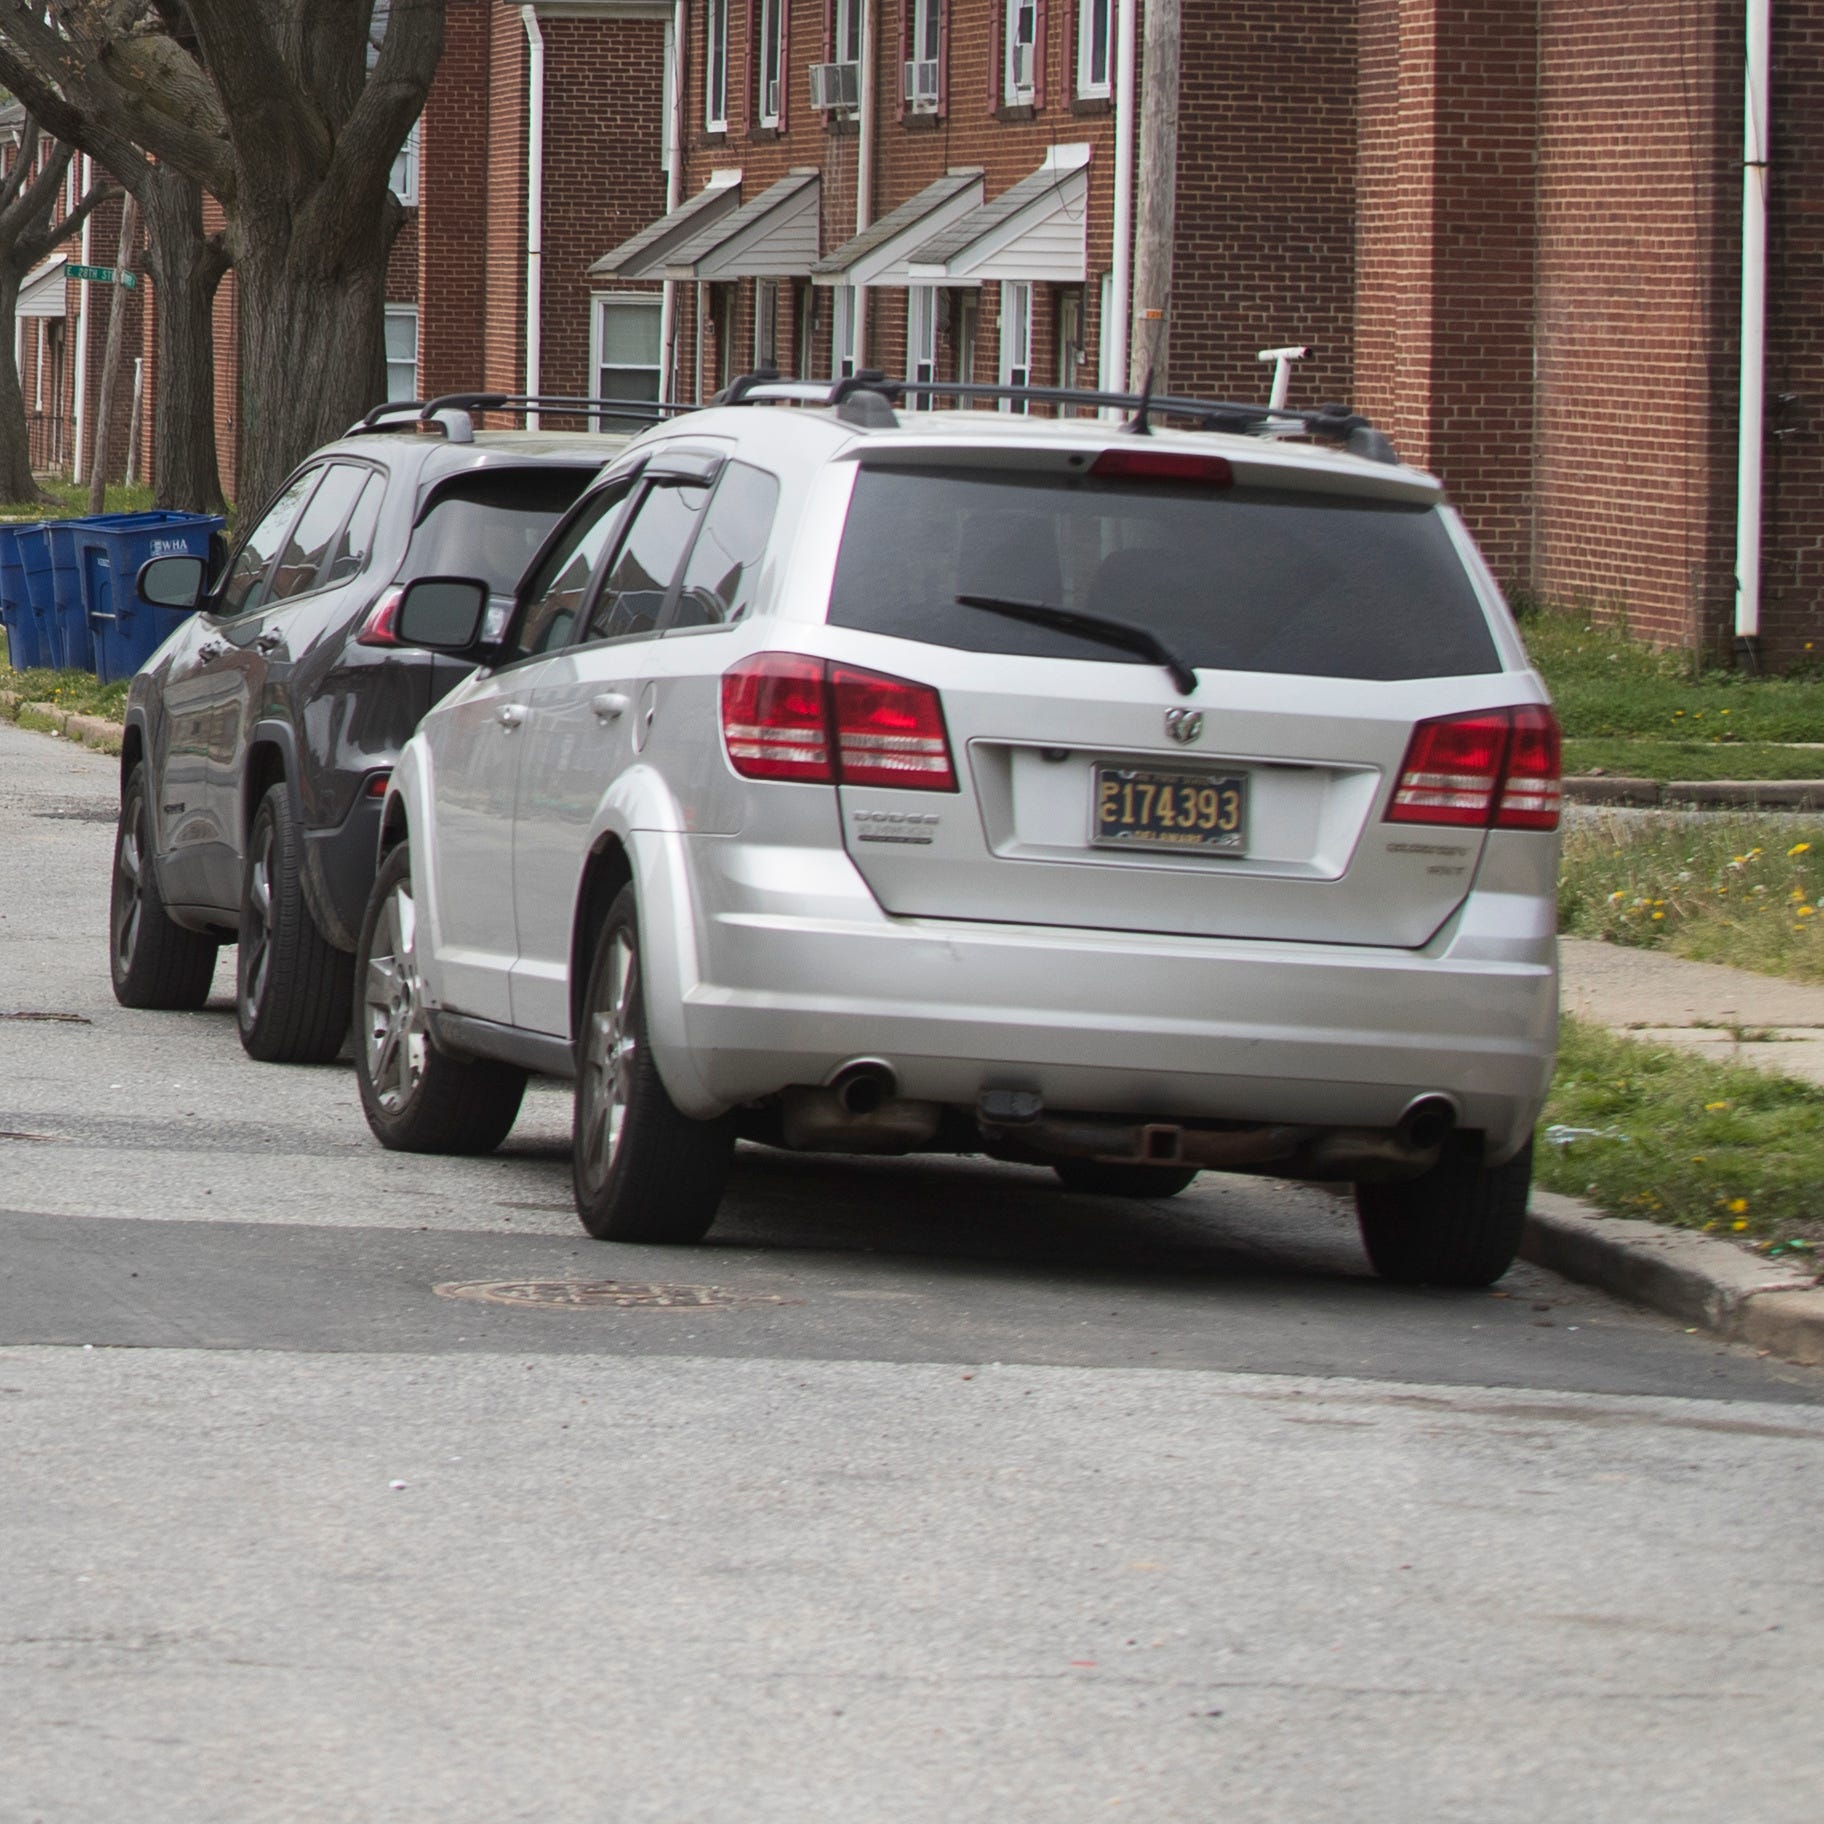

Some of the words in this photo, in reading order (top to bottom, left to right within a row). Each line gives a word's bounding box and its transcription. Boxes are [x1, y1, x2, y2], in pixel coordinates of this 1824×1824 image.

[78, 267, 98, 279] 28TH
[102, 269, 113, 281] ST
[161, 538, 188, 552] WHA
[1120, 781, 1240, 832] 174393
[852, 809, 940, 825] DODGE
